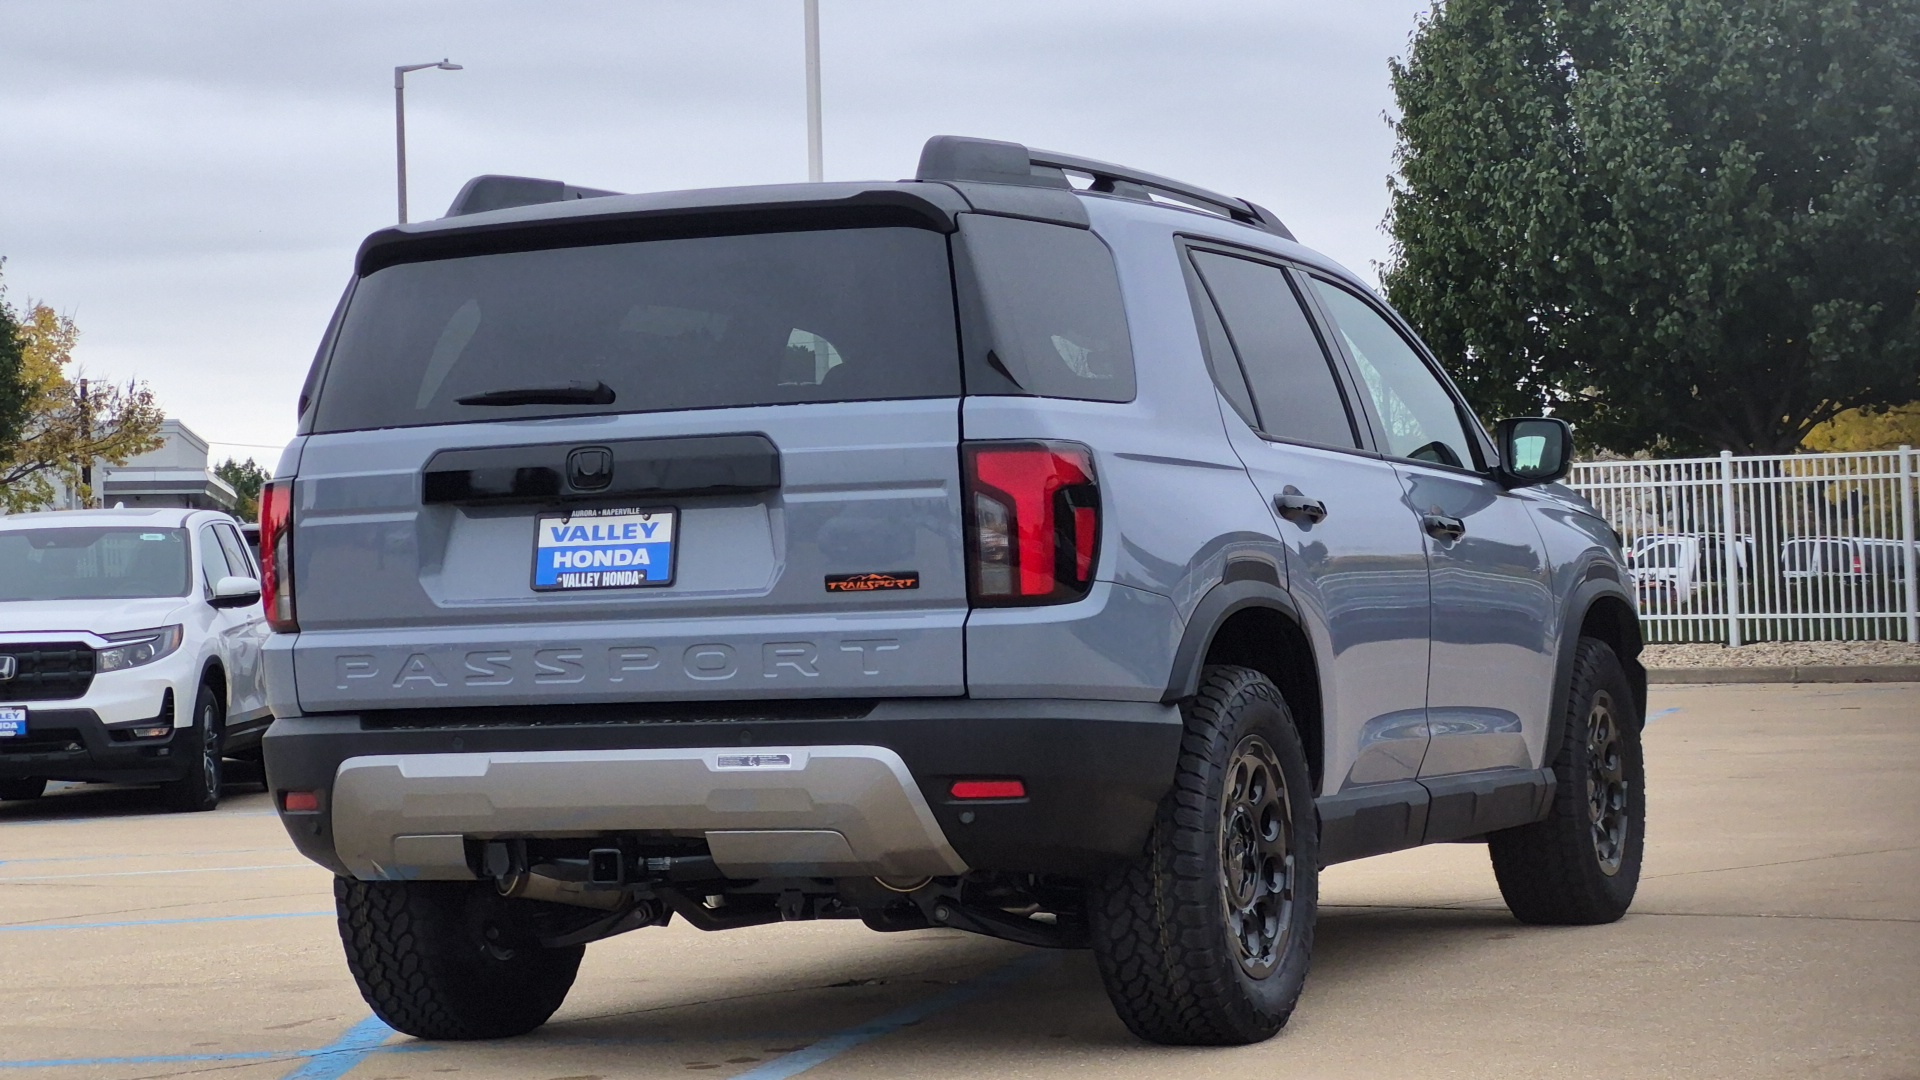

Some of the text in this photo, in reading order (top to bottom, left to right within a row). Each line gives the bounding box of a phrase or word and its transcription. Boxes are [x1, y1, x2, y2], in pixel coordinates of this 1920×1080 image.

[571, 507, 640, 518] AURORA NAPERVILLE
[550, 521, 660, 543] VALLEY
[553, 548, 651, 568] HONDA
[562, 570, 639, 588] VALLEY HONDA
[827, 578, 916, 591] TRAILSPORT
[335, 638, 900, 689] PASSPORT
